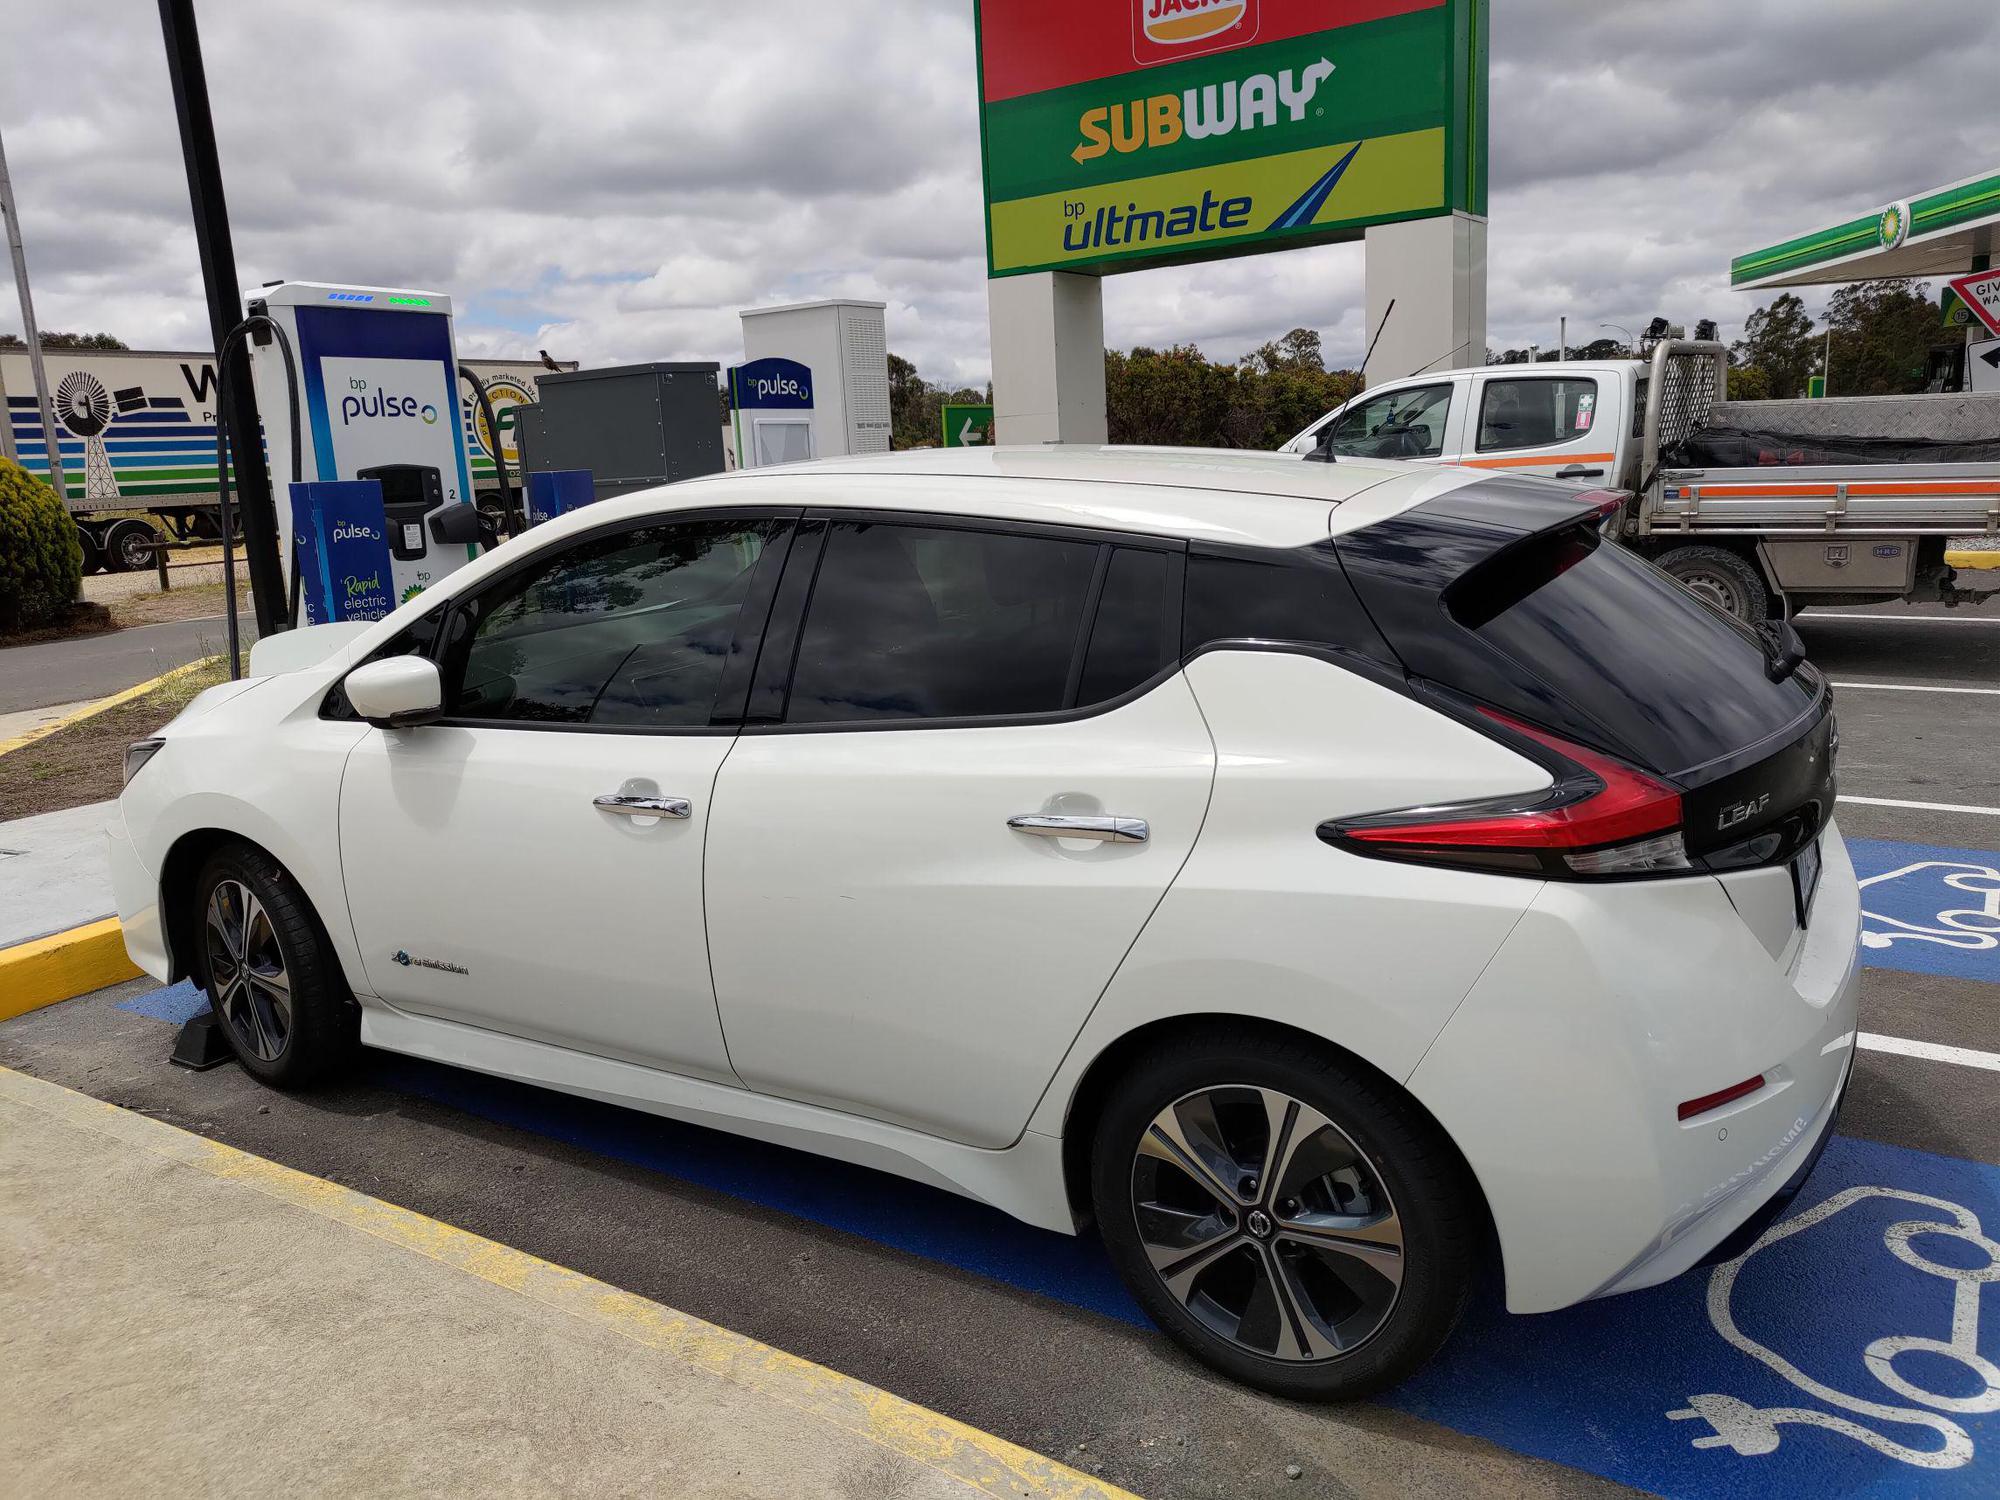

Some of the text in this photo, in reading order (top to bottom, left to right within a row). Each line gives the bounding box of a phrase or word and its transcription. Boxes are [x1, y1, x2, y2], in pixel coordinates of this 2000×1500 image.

[1070, 56, 1336, 165] SUBWAY
[1064, 200, 1085, 220] bp
[1063, 190, 1253, 251] ultimate
[1976, 281, 2000, 296] GIV
[1982, 294, 2000, 305] WA
[349, 376, 367, 392] bp
[758, 373, 798, 400] pulse
[342, 387, 418, 425] pulse
[449, 489, 456, 499] 2
[337, 519, 346, 527] bp
[333, 524, 371, 543] pulse
[344, 570, 381, 598] Rapid
[417, 571, 430, 582] bp
[344, 595, 387, 610] electric
[347, 608, 387, 622] vehicle
[1717, 793, 1770, 831] LEAF
